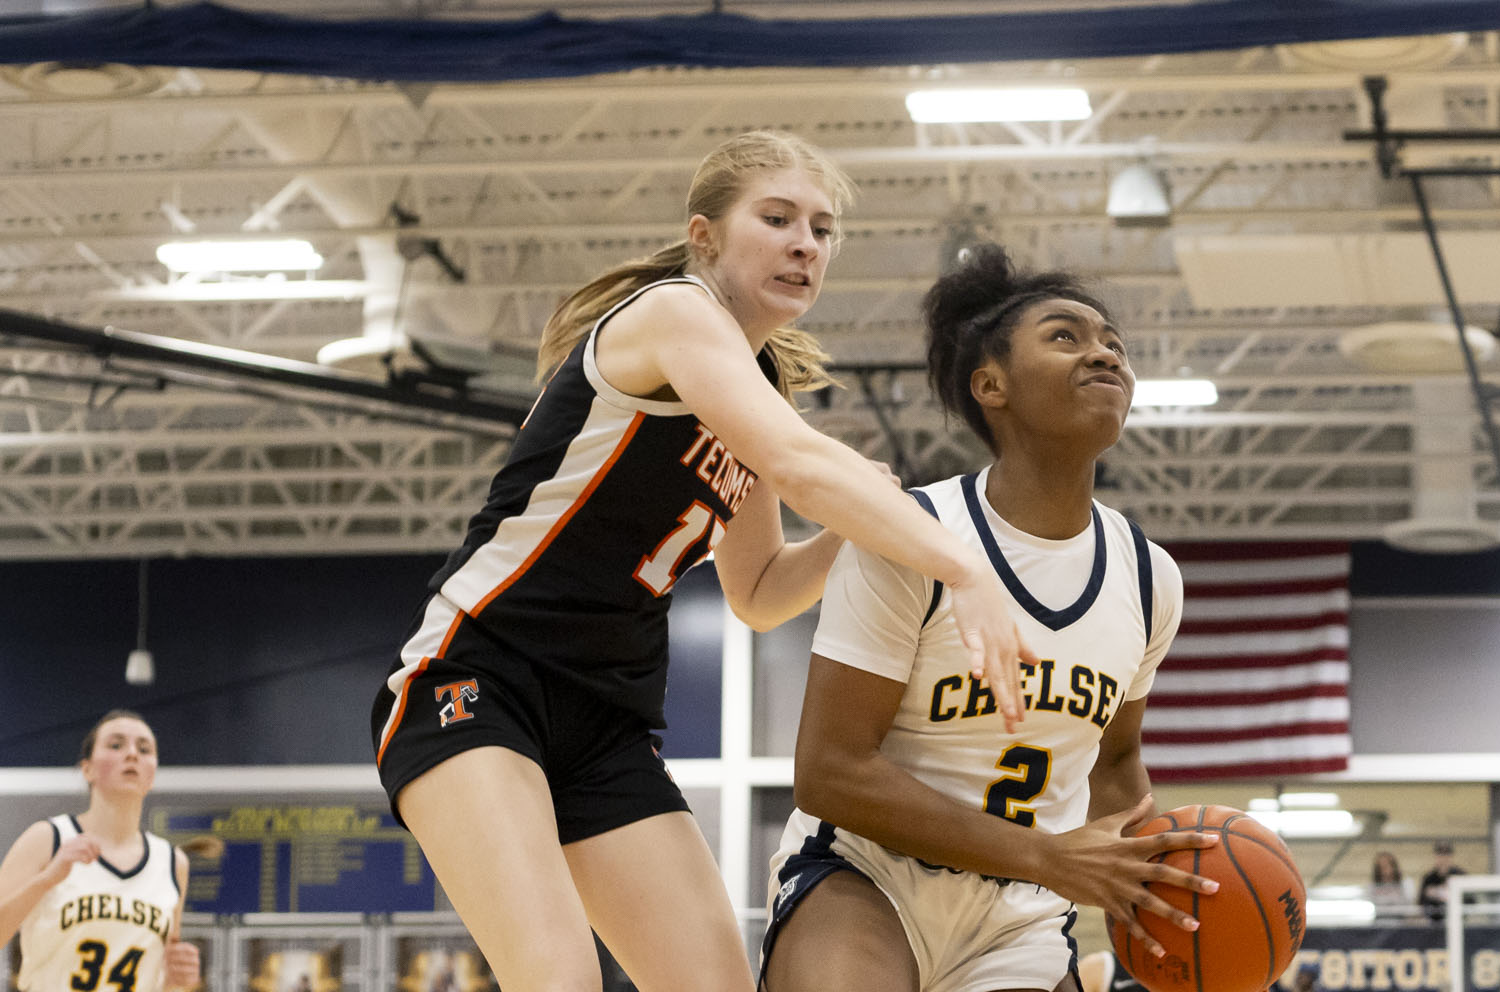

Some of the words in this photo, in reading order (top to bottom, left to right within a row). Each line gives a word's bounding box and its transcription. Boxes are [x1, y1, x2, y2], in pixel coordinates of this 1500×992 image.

[679, 421, 757, 516] TECUMS
[929, 659, 1125, 731] CHELSE
[983, 742, 1052, 828] 2
[1279, 949, 1453, 990] SITOR
